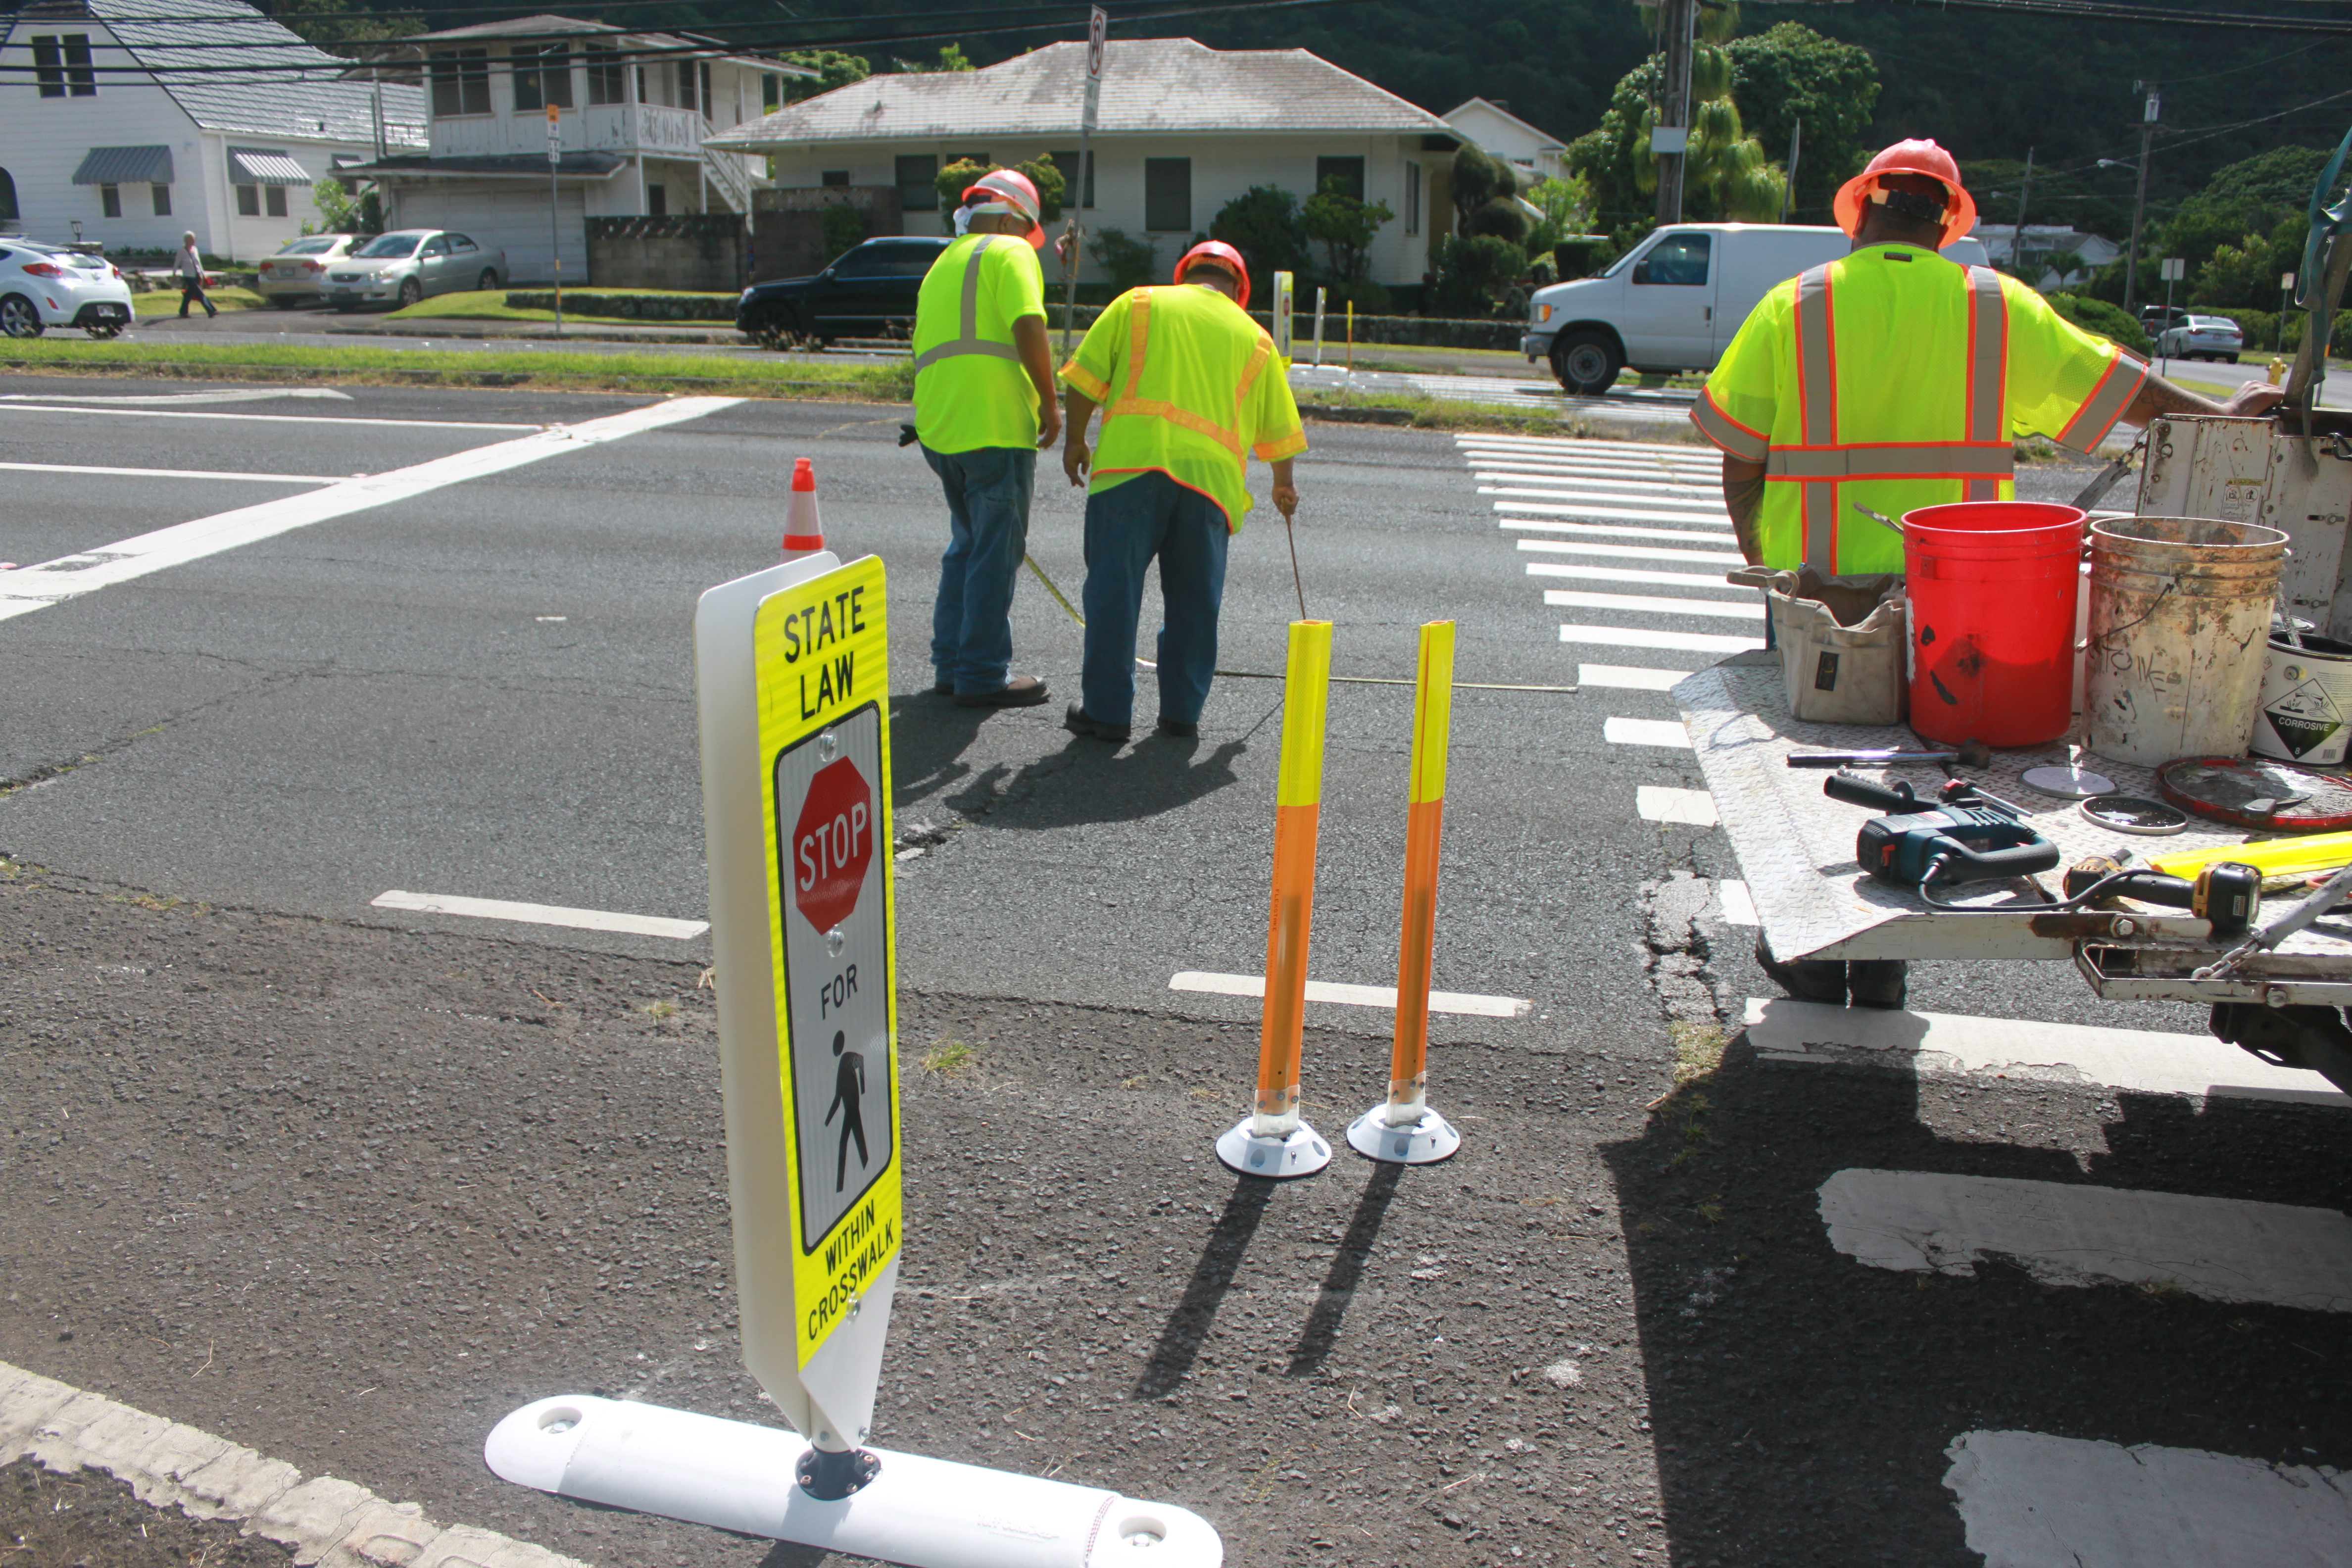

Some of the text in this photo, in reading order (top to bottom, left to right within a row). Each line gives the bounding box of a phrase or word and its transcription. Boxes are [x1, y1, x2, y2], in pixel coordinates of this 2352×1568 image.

[784, 585, 865, 663] STATE
[800, 651, 854, 721] LAW
[2278, 717, 2330, 732] CORROSIVE
[800, 801, 867, 891] STOP
[821, 964, 858, 1020] FOR
[825, 1199, 875, 1276] WITHIN
[808, 1218, 894, 1340] CROSSWALK
